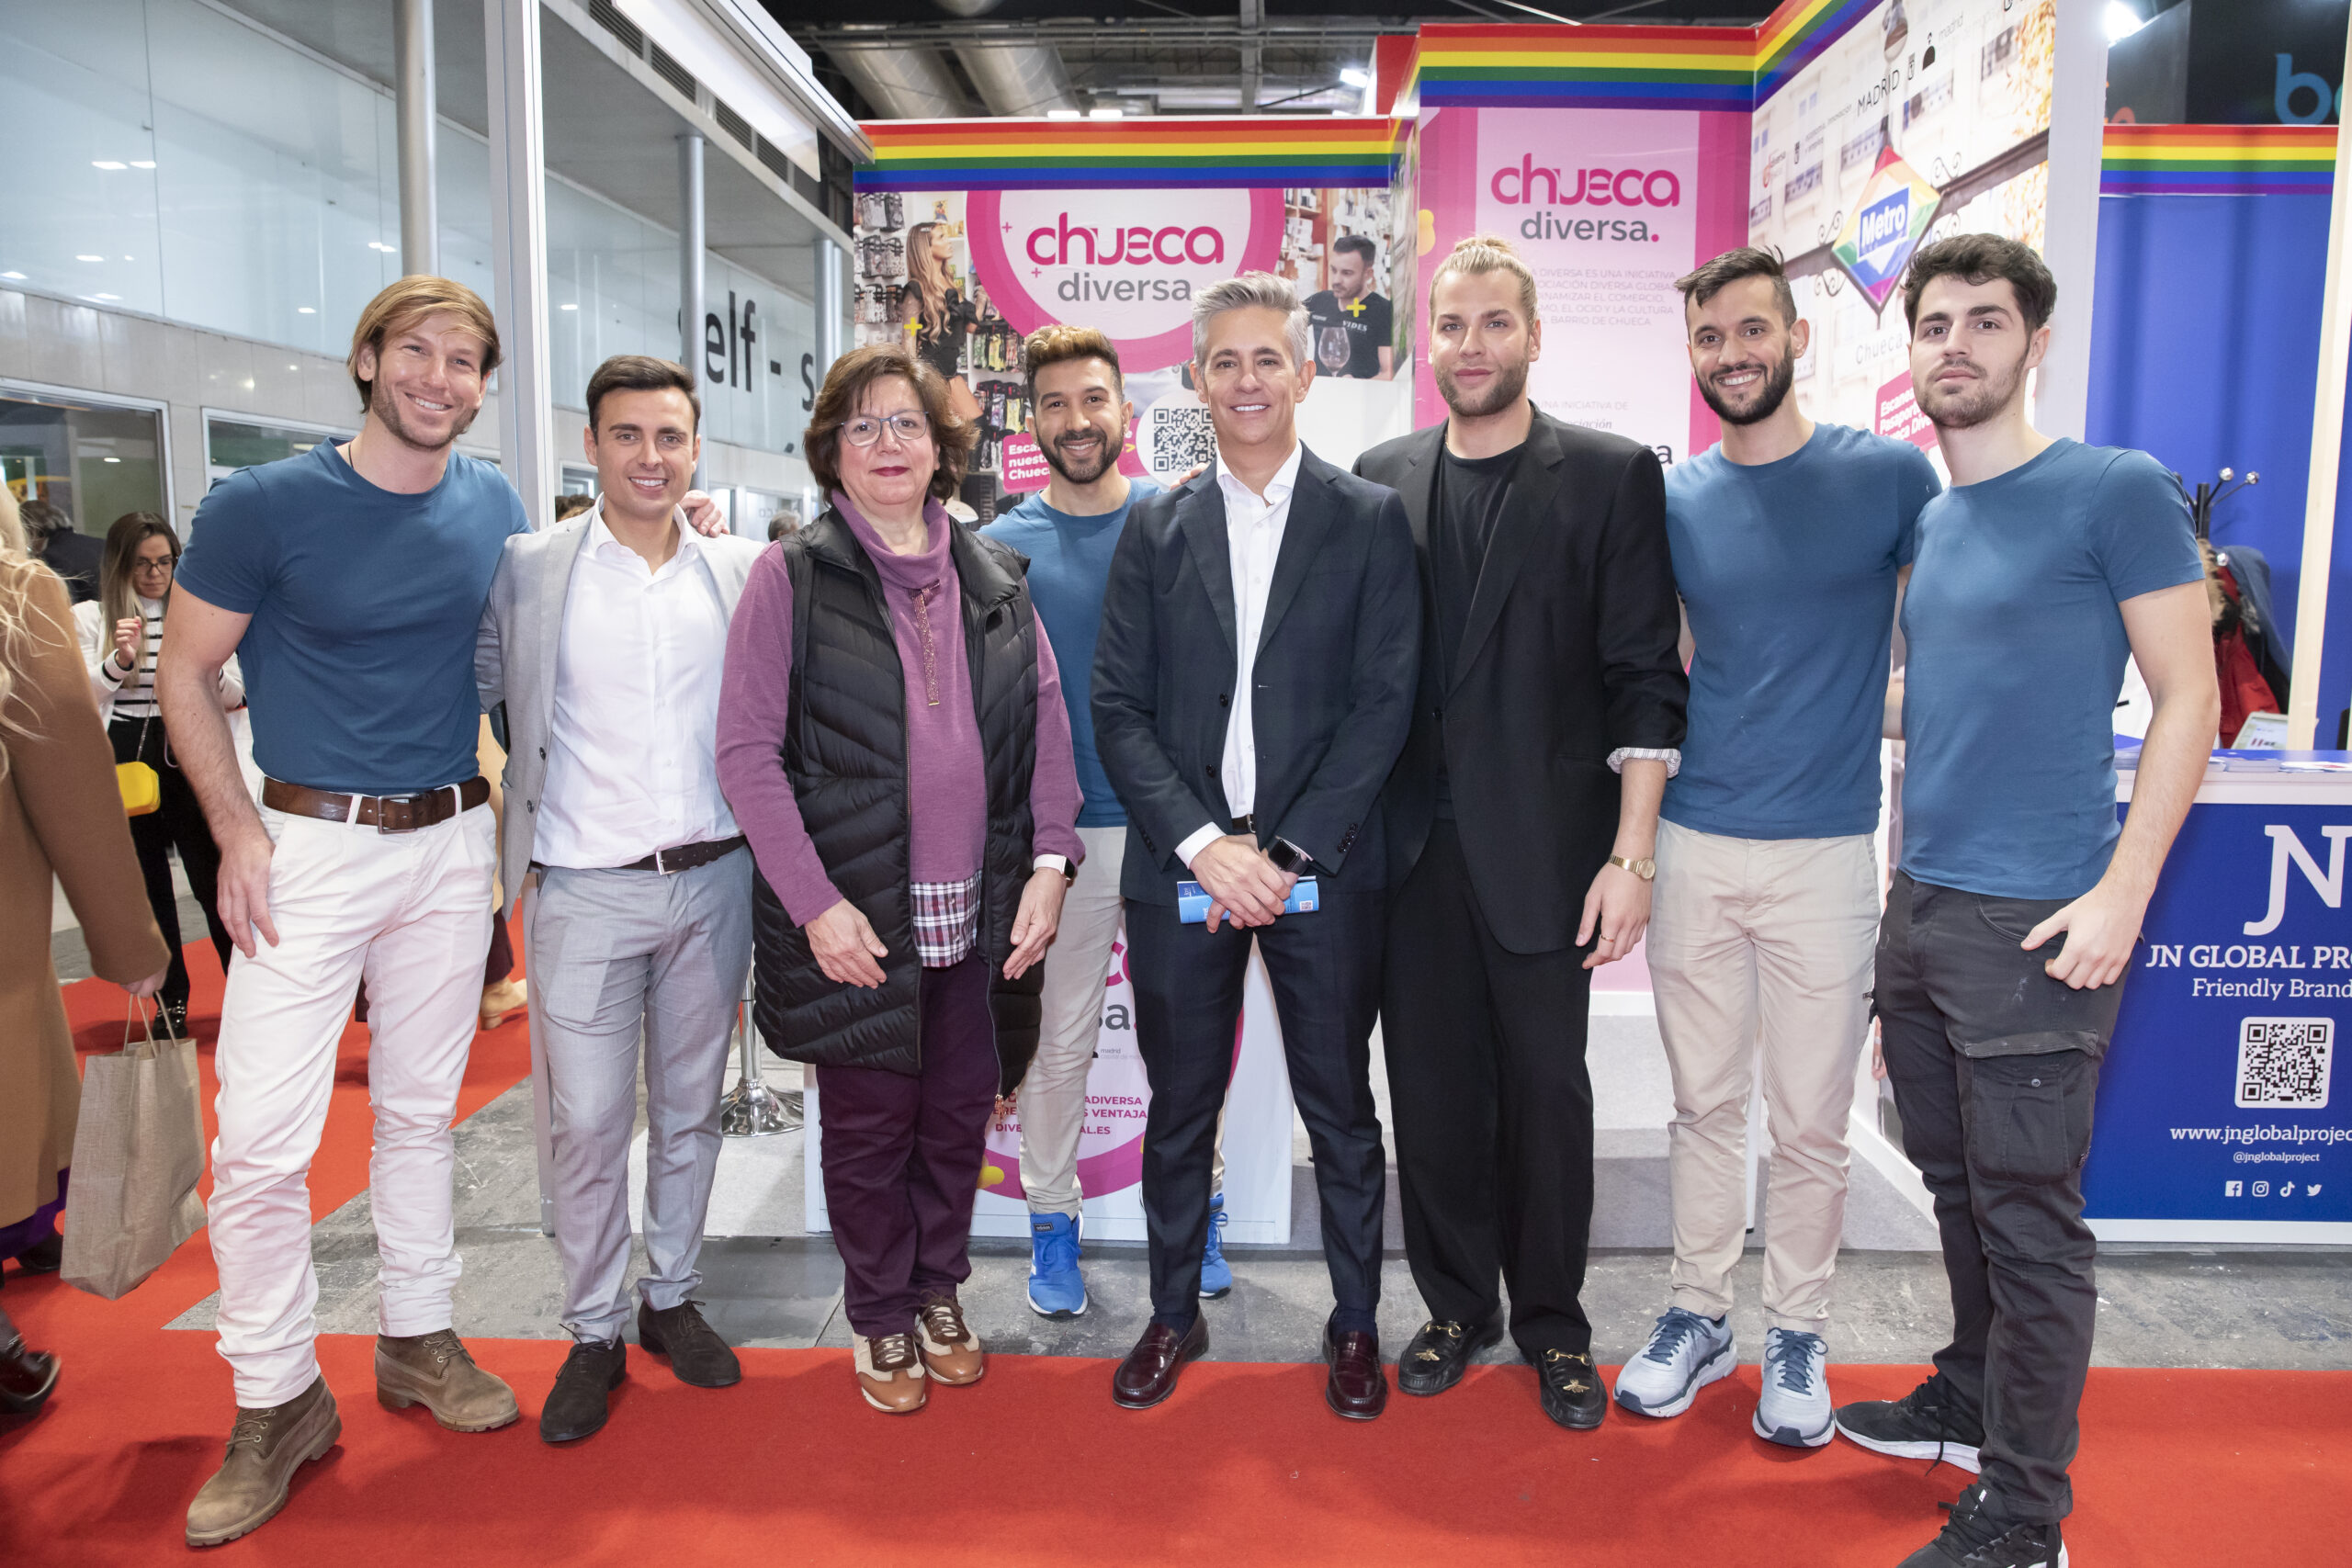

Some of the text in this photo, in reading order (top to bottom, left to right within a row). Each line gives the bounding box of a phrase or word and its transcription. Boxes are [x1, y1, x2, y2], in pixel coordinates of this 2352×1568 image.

[1857, 69, 1900, 117] MADRID
[1491, 152, 1680, 208] chueca
[1521, 211, 1659, 243] diversa.
[1861, 204, 1906, 247] Metro
[1026, 212, 1225, 265] chueca
[1540, 268, 1582, 277] DIVERSA
[1600, 269, 1623, 278] UNA
[1625, 270, 1676, 279] INICIATIVA
[1590, 280, 1634, 290] DIVERSA
[1594, 293, 1606, 302] EL
[1562, 304, 1574, 313] EL
[1576, 304, 1603, 313] OCIO
[1605, 305, 1611, 313] Y
[1613, 305, 1625, 314] LA
[1628, 305, 1674, 315] CULTURA
[1551, 316, 1589, 325] BARRIO
[1592, 316, 1606, 325] DE
[1856, 333, 1903, 365] Chueca
[1615, 401, 1629, 411] DE
[1009, 444, 1041, 455] Esca
[1009, 468, 1050, 480] Chuec
[2243, 825, 2352, 936] JN
[2145, 944, 2352, 969] JN GLOBAL PR
[2192, 977, 2284, 1001] Friendly
[1084, 1096, 1143, 1105] ADIVERSA
[1092, 1109, 1148, 1119] VENTAJA
[2170, 1124, 2352, 1145] www.jnglobalprojec
[2233, 1152, 2320, 1164] @jnglobalproject
